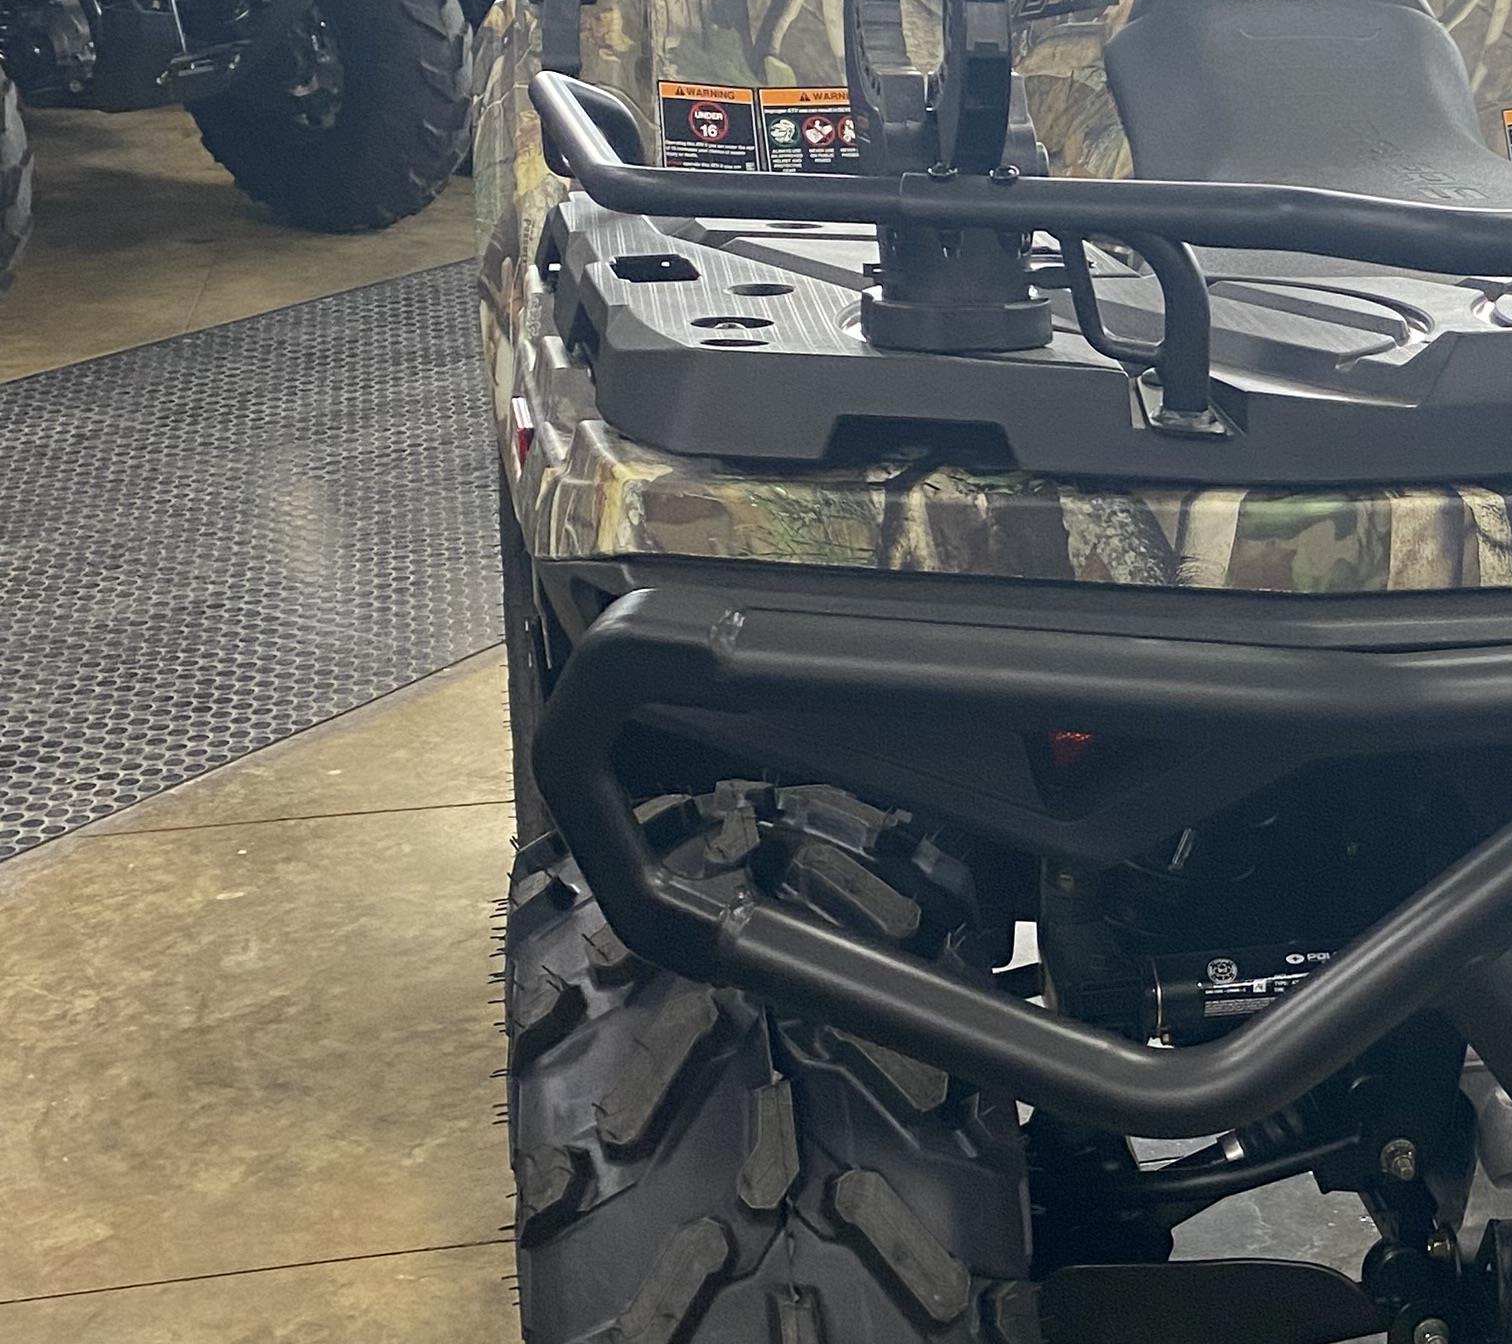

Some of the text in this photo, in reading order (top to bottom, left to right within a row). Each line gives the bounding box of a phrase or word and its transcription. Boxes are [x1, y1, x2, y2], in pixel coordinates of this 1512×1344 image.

[686, 87, 736, 101] WARNING
[694, 110, 724, 121] UNDER
[700, 124, 719, 138] 16
